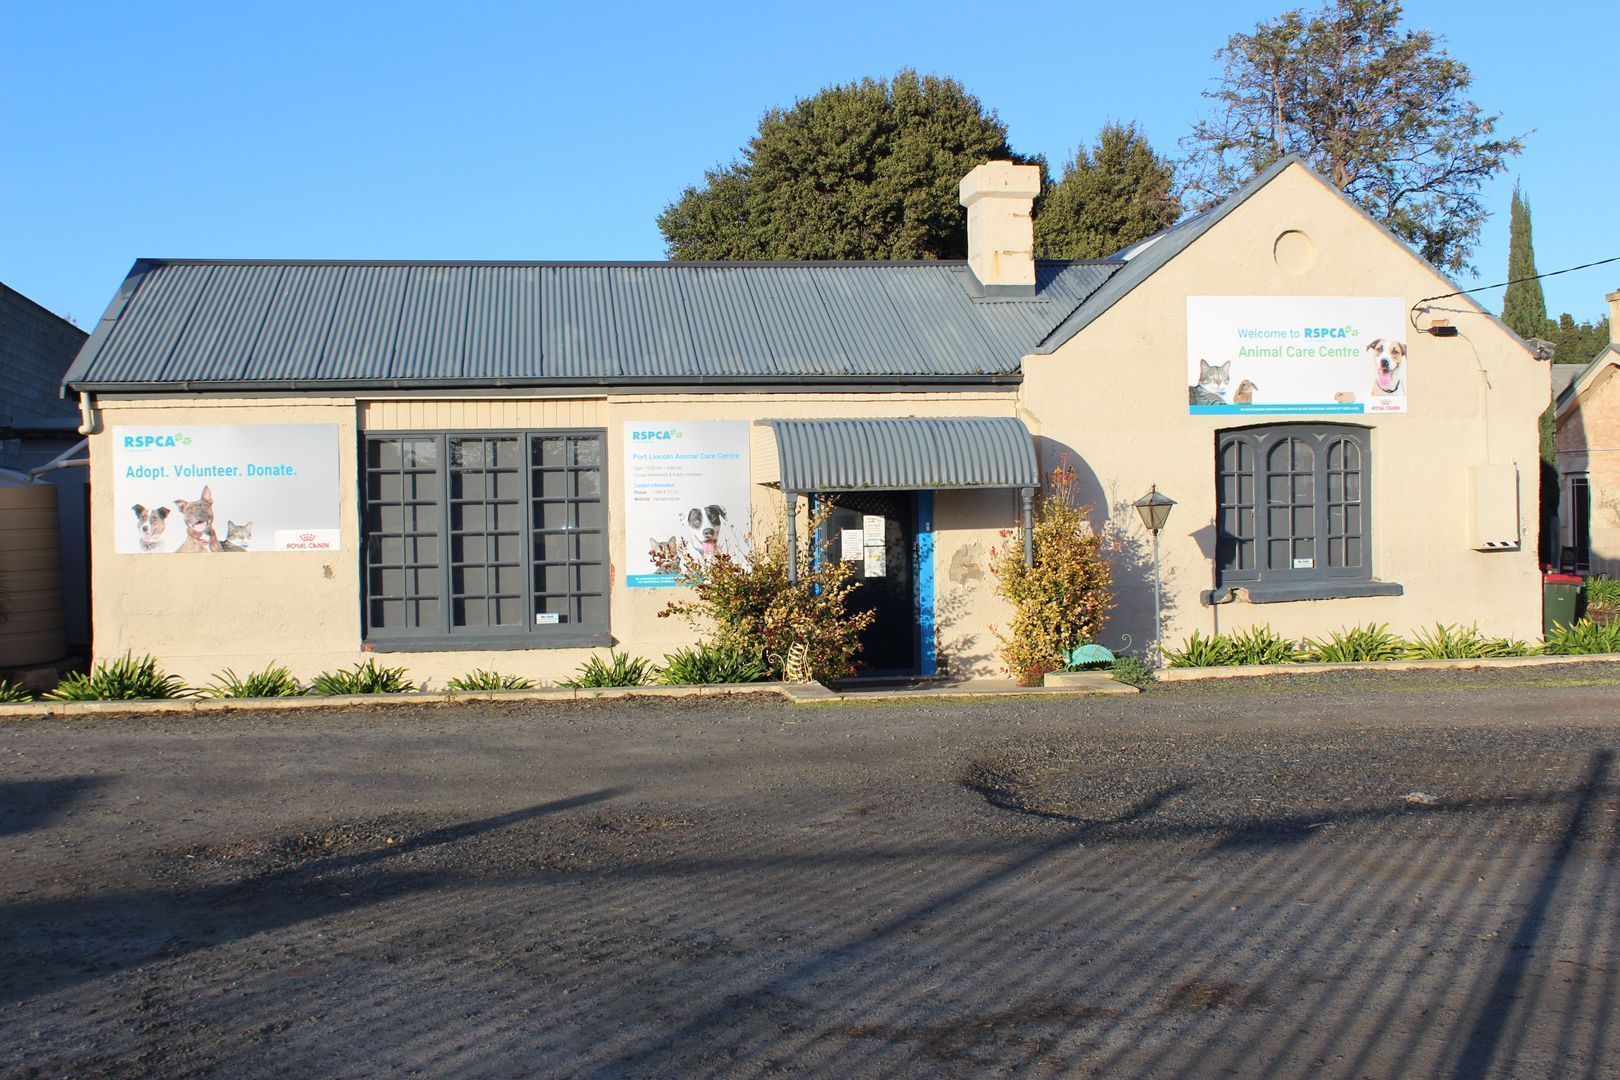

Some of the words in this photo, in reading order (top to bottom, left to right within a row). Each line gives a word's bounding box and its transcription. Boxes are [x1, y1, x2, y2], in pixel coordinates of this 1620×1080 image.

[1237, 328, 1288, 339] Welcome
[1289, 329, 1300, 339] to
[1304, 328, 1346, 338] RSPCA
[1238, 346, 1282, 358] Animal
[1286, 346, 1316, 358] Care
[1319, 346, 1360, 358] Centre
[632, 431, 671, 440] RSPCA
[124, 436, 176, 448] RSPCA
[125, 465, 170, 481] Adopt.
[173, 464, 243, 477] Volunteer.
[246, 464, 298, 477] Donate.
